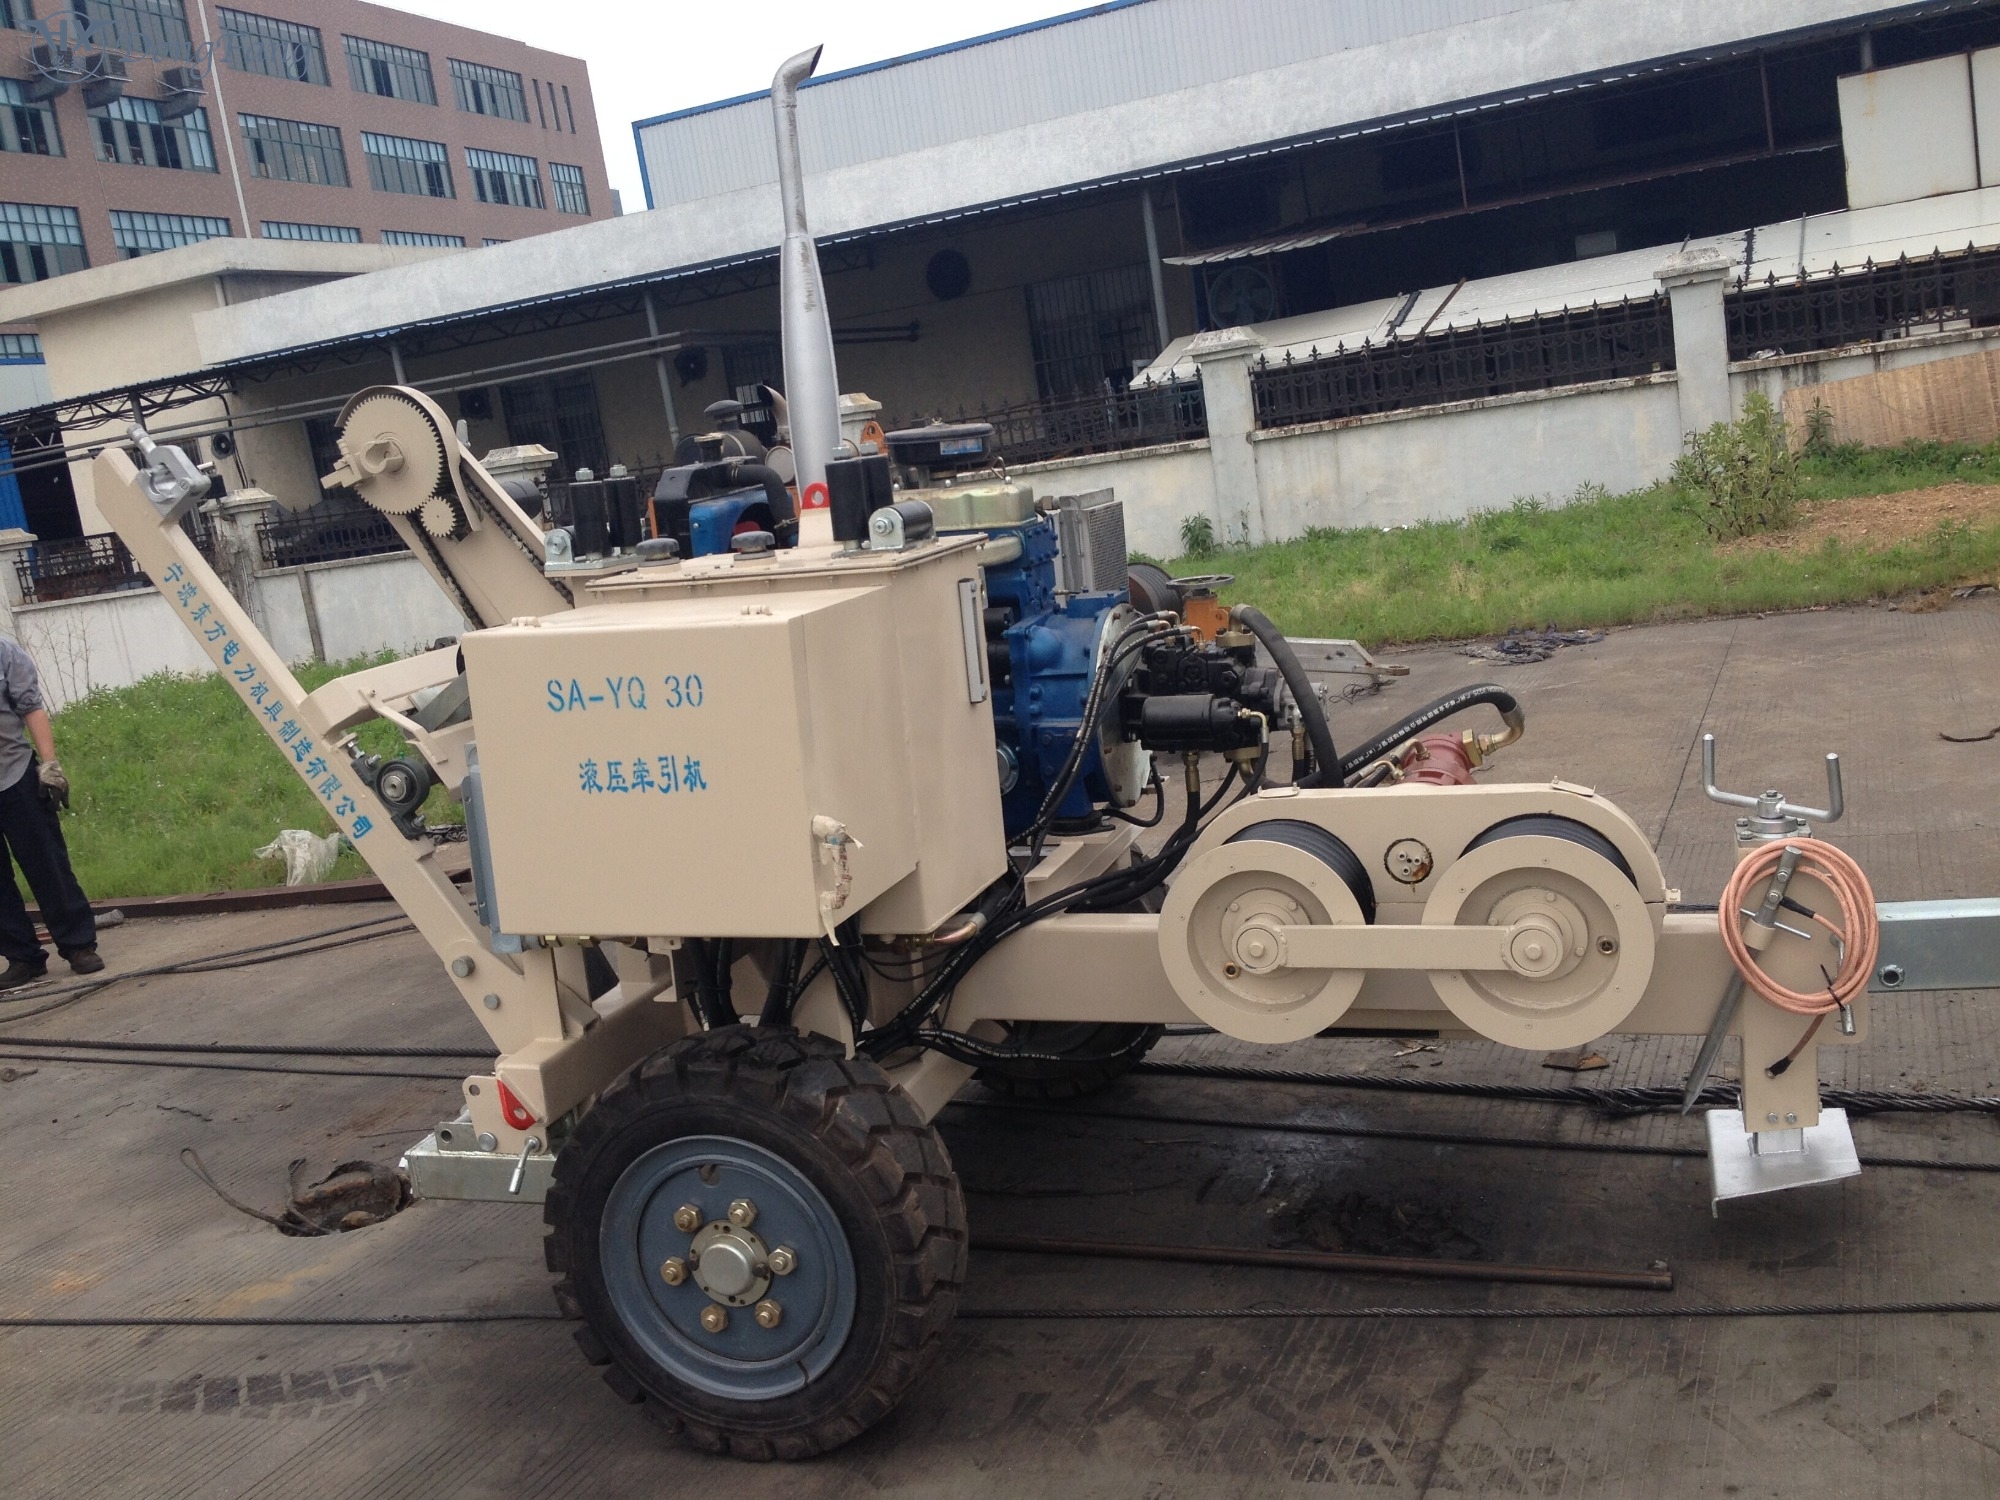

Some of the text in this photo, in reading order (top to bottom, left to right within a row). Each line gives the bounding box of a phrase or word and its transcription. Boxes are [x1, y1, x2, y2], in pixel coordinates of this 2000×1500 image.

[547, 673, 703, 712] SA-YQ 30
[578, 754, 708, 794] 液压牵引机
